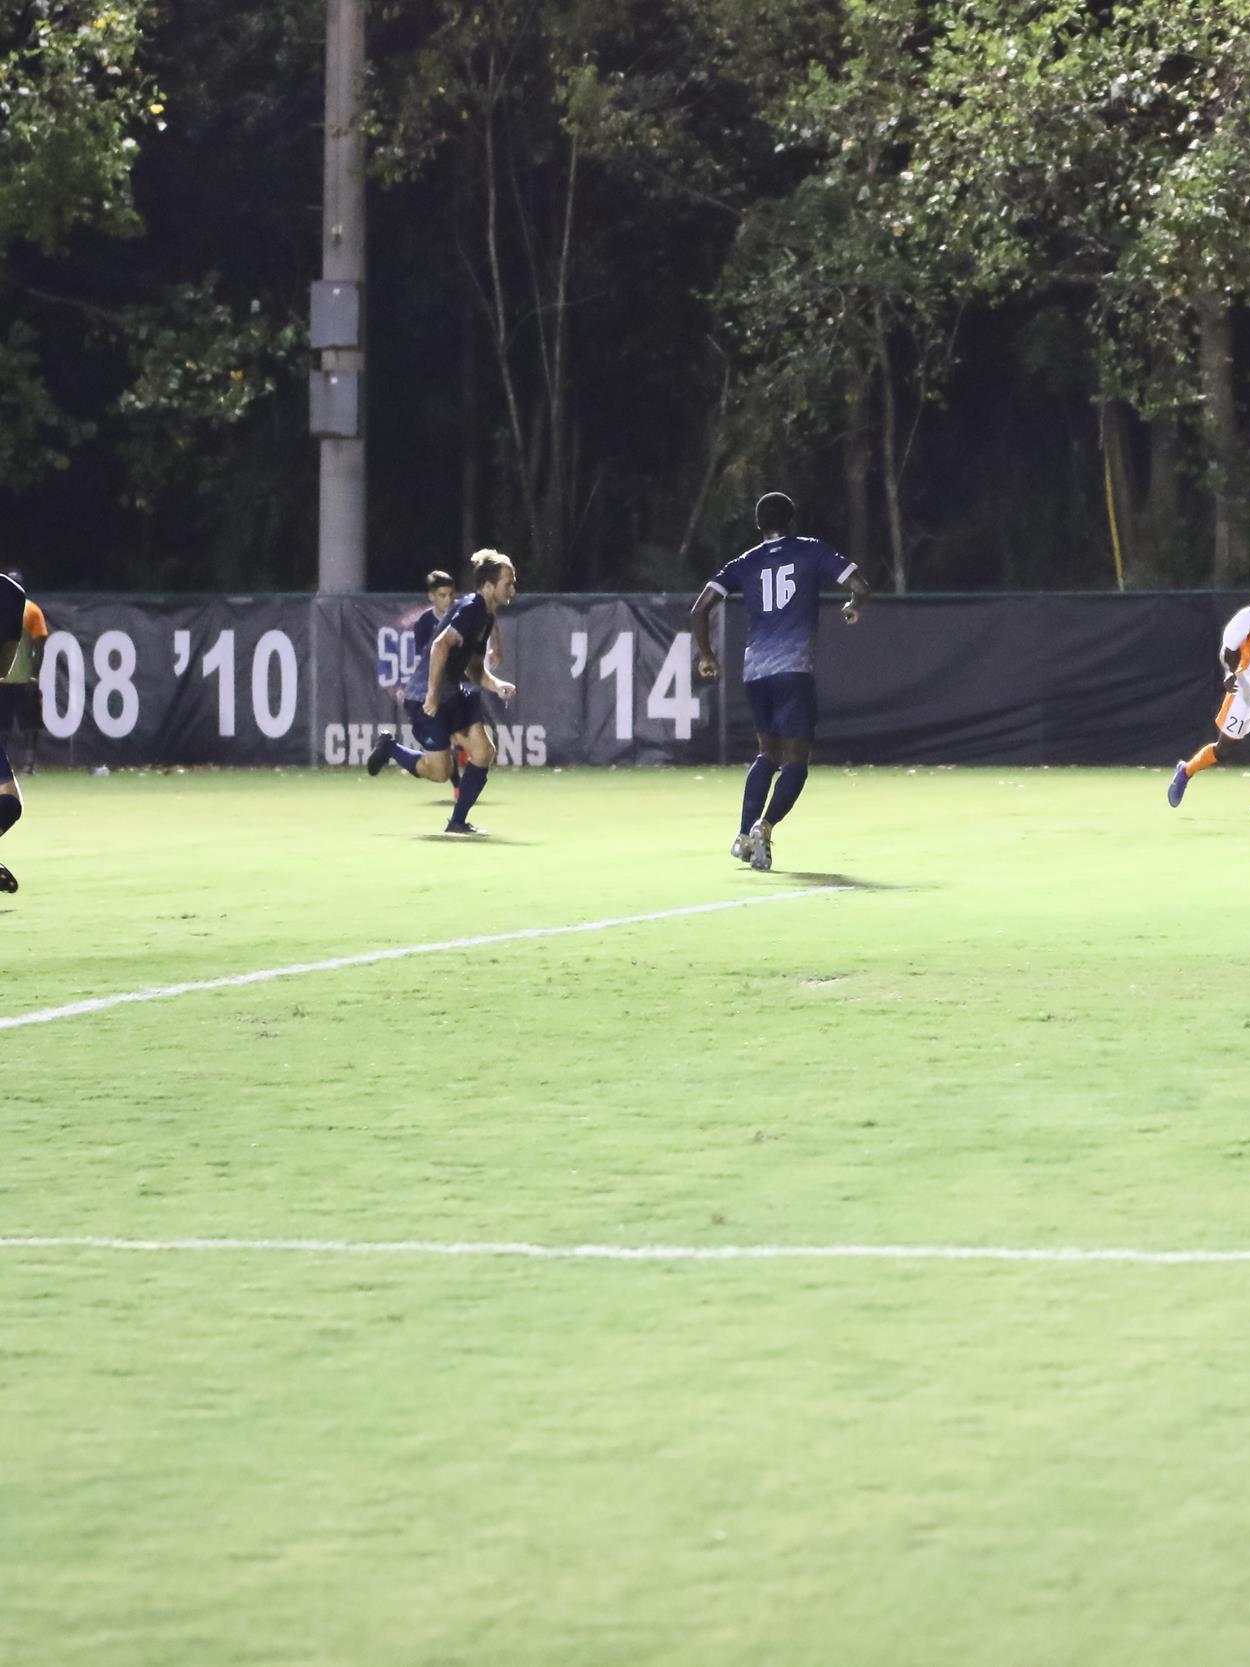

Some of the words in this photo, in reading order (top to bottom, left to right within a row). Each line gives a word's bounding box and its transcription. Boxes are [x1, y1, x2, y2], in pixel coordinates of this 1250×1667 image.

[760, 563, 796, 612] 16
[39, 630, 139, 738] 08
[174, 629, 298, 738] '10
[571, 632, 699, 739] '14
[1226, 716, 1244, 734] 21
